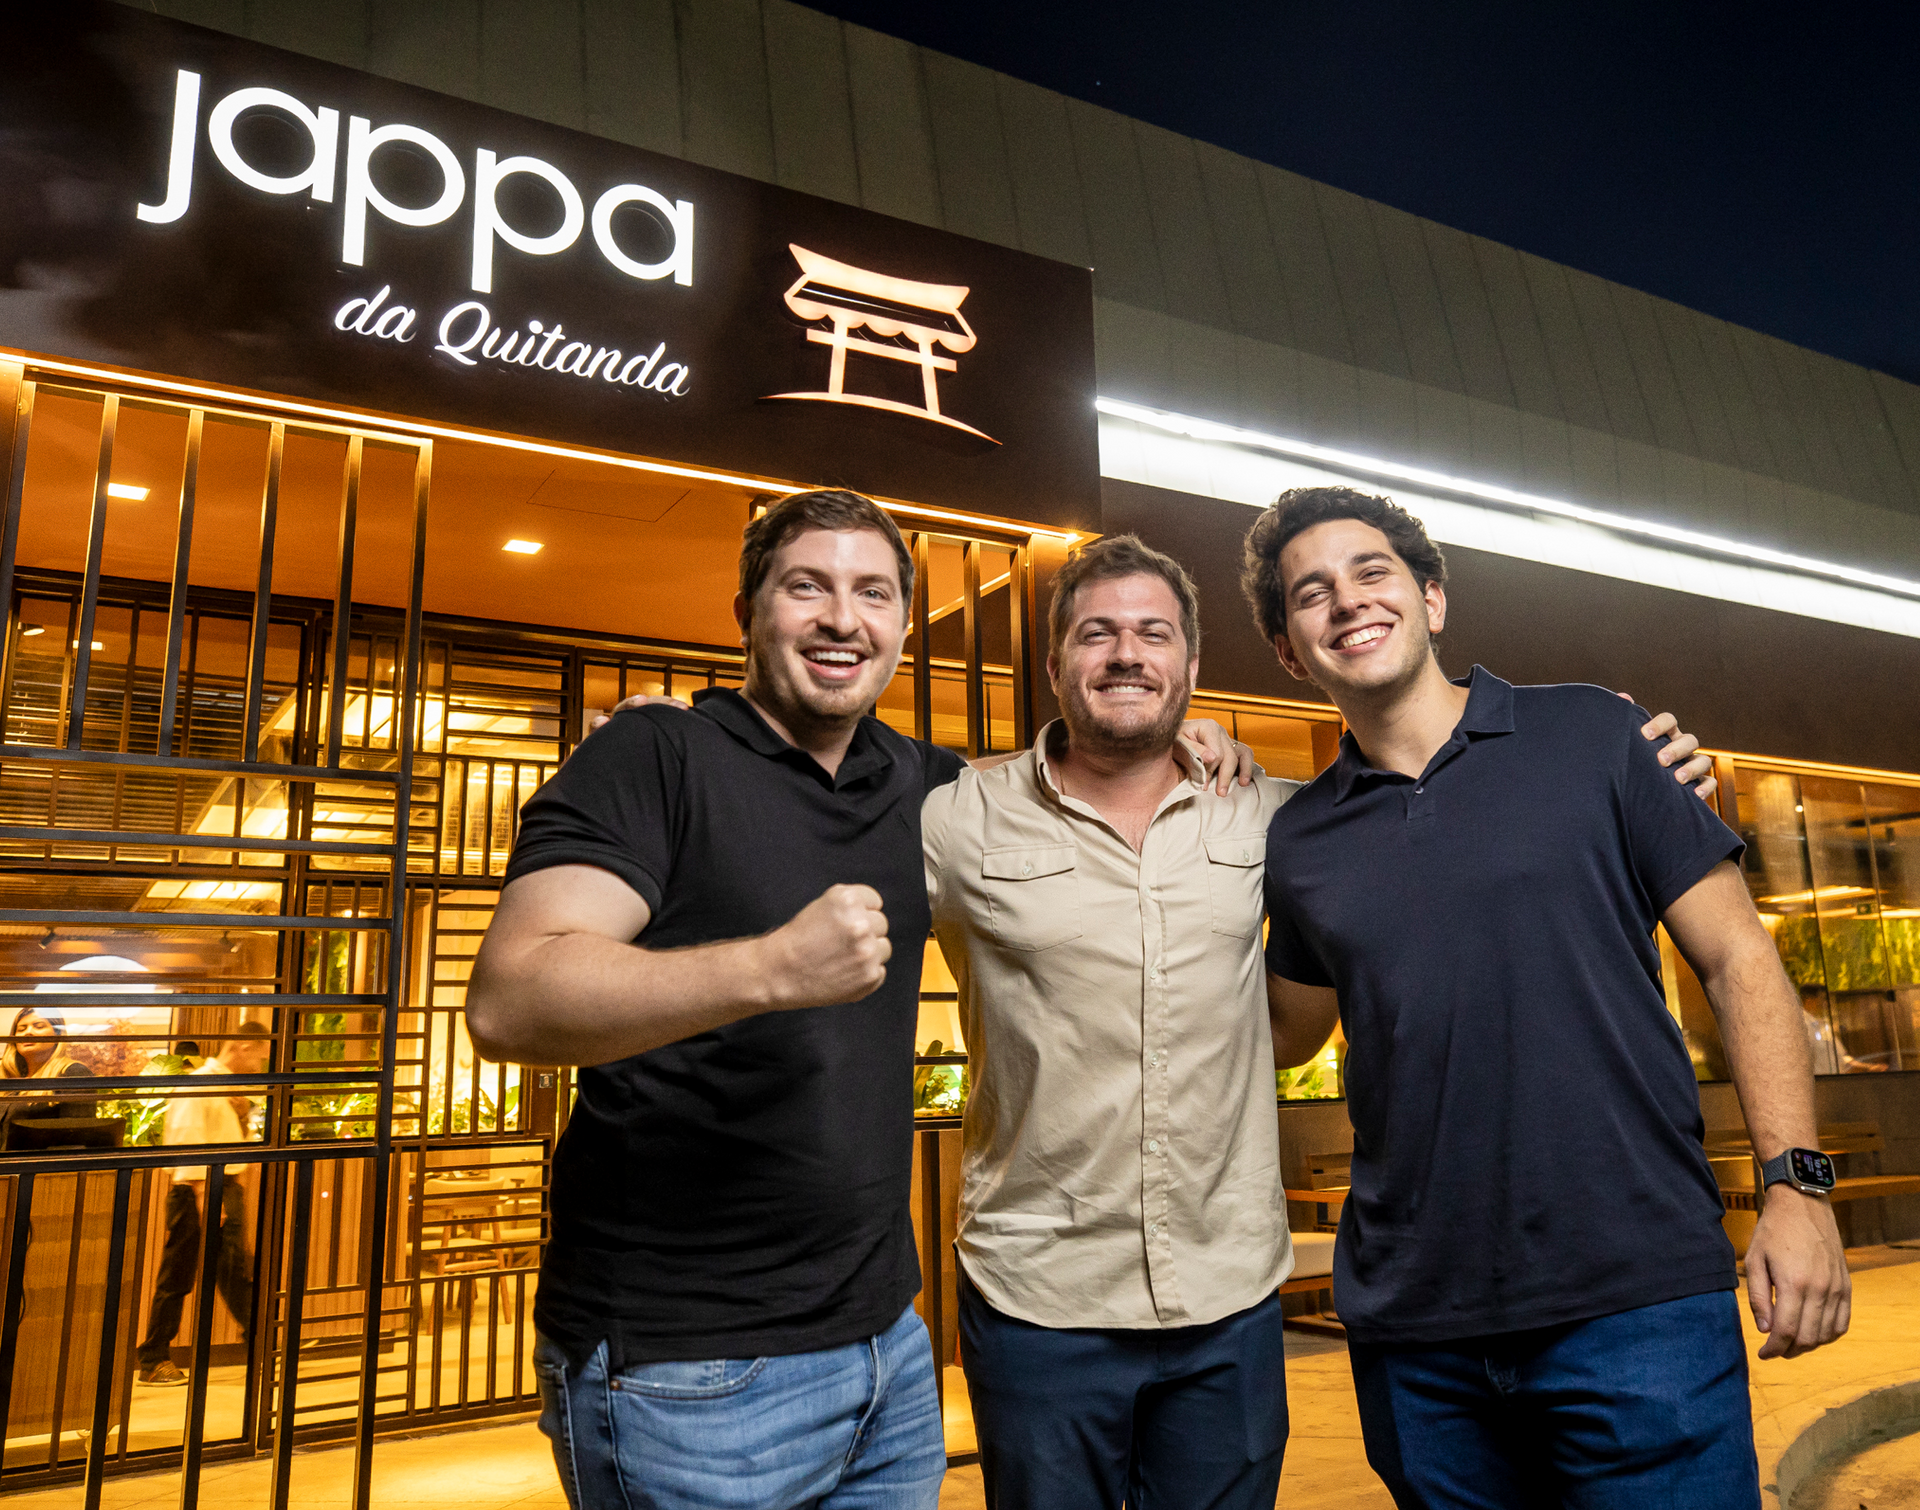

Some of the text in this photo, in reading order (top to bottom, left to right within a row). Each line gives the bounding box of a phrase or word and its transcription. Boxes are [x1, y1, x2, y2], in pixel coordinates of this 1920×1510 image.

[136, 68, 695, 294] jappa
[334, 284, 691, 397] da Quitanda
